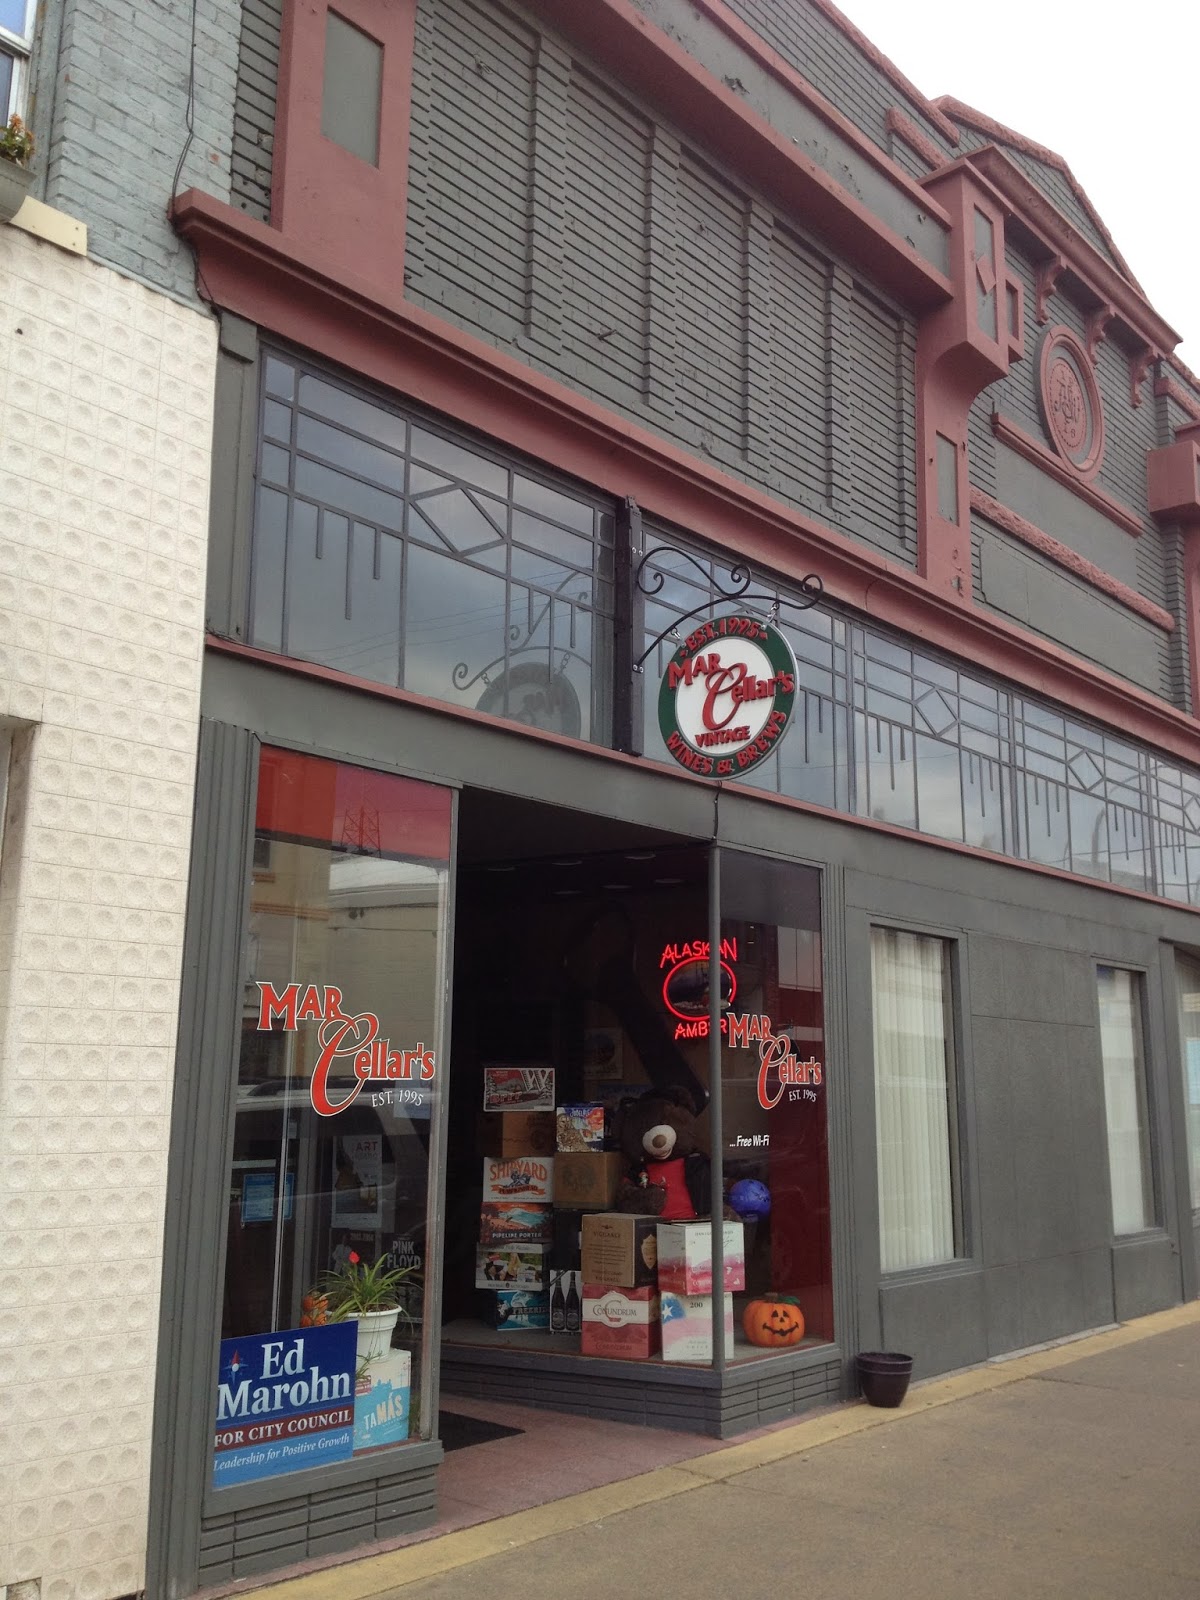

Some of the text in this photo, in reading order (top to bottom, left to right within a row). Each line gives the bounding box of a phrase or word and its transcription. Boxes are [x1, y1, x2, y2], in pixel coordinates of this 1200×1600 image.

[667, 652, 722, 690] MAR
[702, 662, 795, 731] Cellar's
[665, 710, 787, 774] WINES & BREWS
[694, 725, 751, 748] VINTAGE
[660, 937, 738, 968] ALASKN
[256, 981, 343, 1031] MAR
[674, 1018, 728, 1040] AMBR
[726, 1012, 773, 1048] MAR
[310, 1012, 436, 1117] Cellar's
[757, 1034, 823, 1110] Cellar's
[371, 1089, 424, 1108] EST. 1995
[789, 1089, 817, 1103] EST. 1995
[355, 1141, 378, 1152] ART
[736, 1135, 752, 1147] Free
[752, 1134, 770, 1146] Wi-Fi
[489, 1161, 548, 1182] SHIPYARD
[386, 1254, 422, 1271] FLOYD
[392, 1240, 415, 1255] PINK
[259, 1338, 305, 1380] Ed
[216, 1366, 351, 1421] Marohn
[214, 1410, 351, 1448] FOR CITY COUNCIL
[213, 1433, 350, 1472] Leadership for Positive Growth
